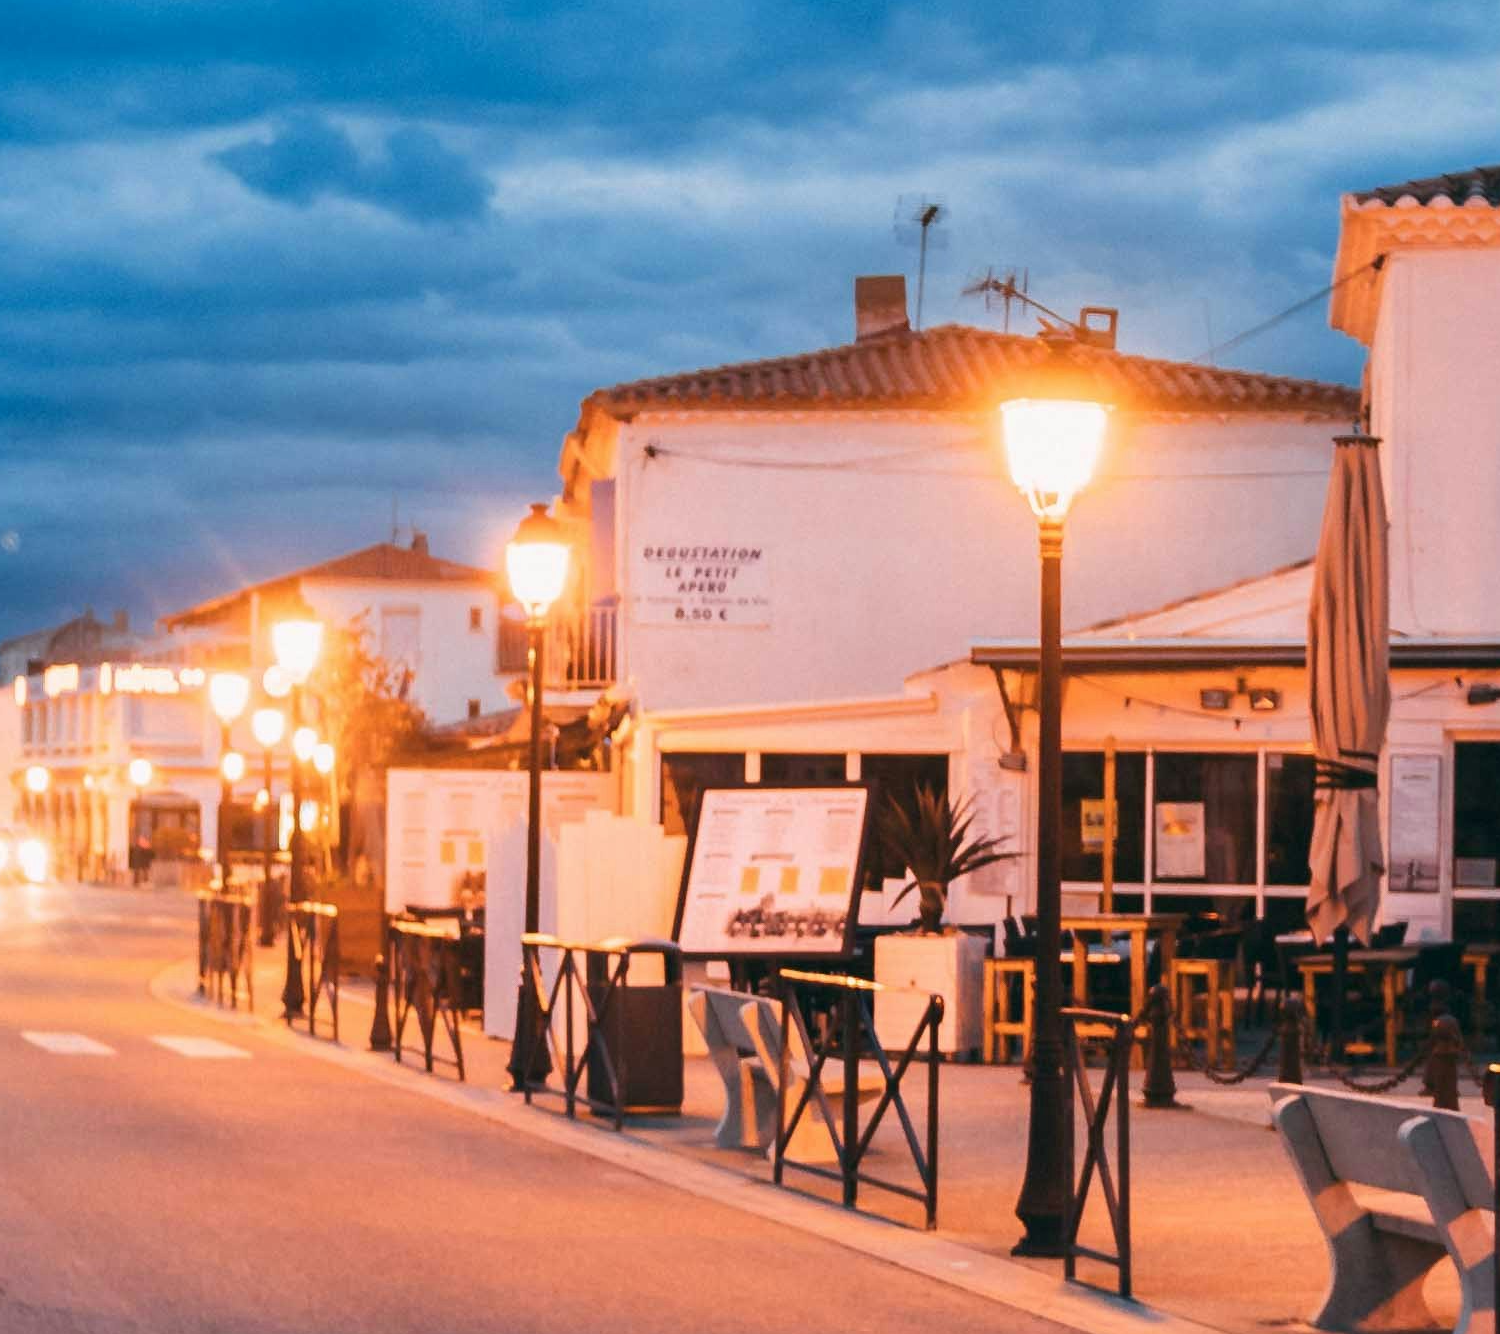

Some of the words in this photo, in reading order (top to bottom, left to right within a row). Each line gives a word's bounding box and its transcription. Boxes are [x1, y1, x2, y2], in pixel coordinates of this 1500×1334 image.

[643, 547, 763, 560] DEGUSTATION
[665, 568, 682, 578] LE
[694, 568, 738, 579] PETIT
